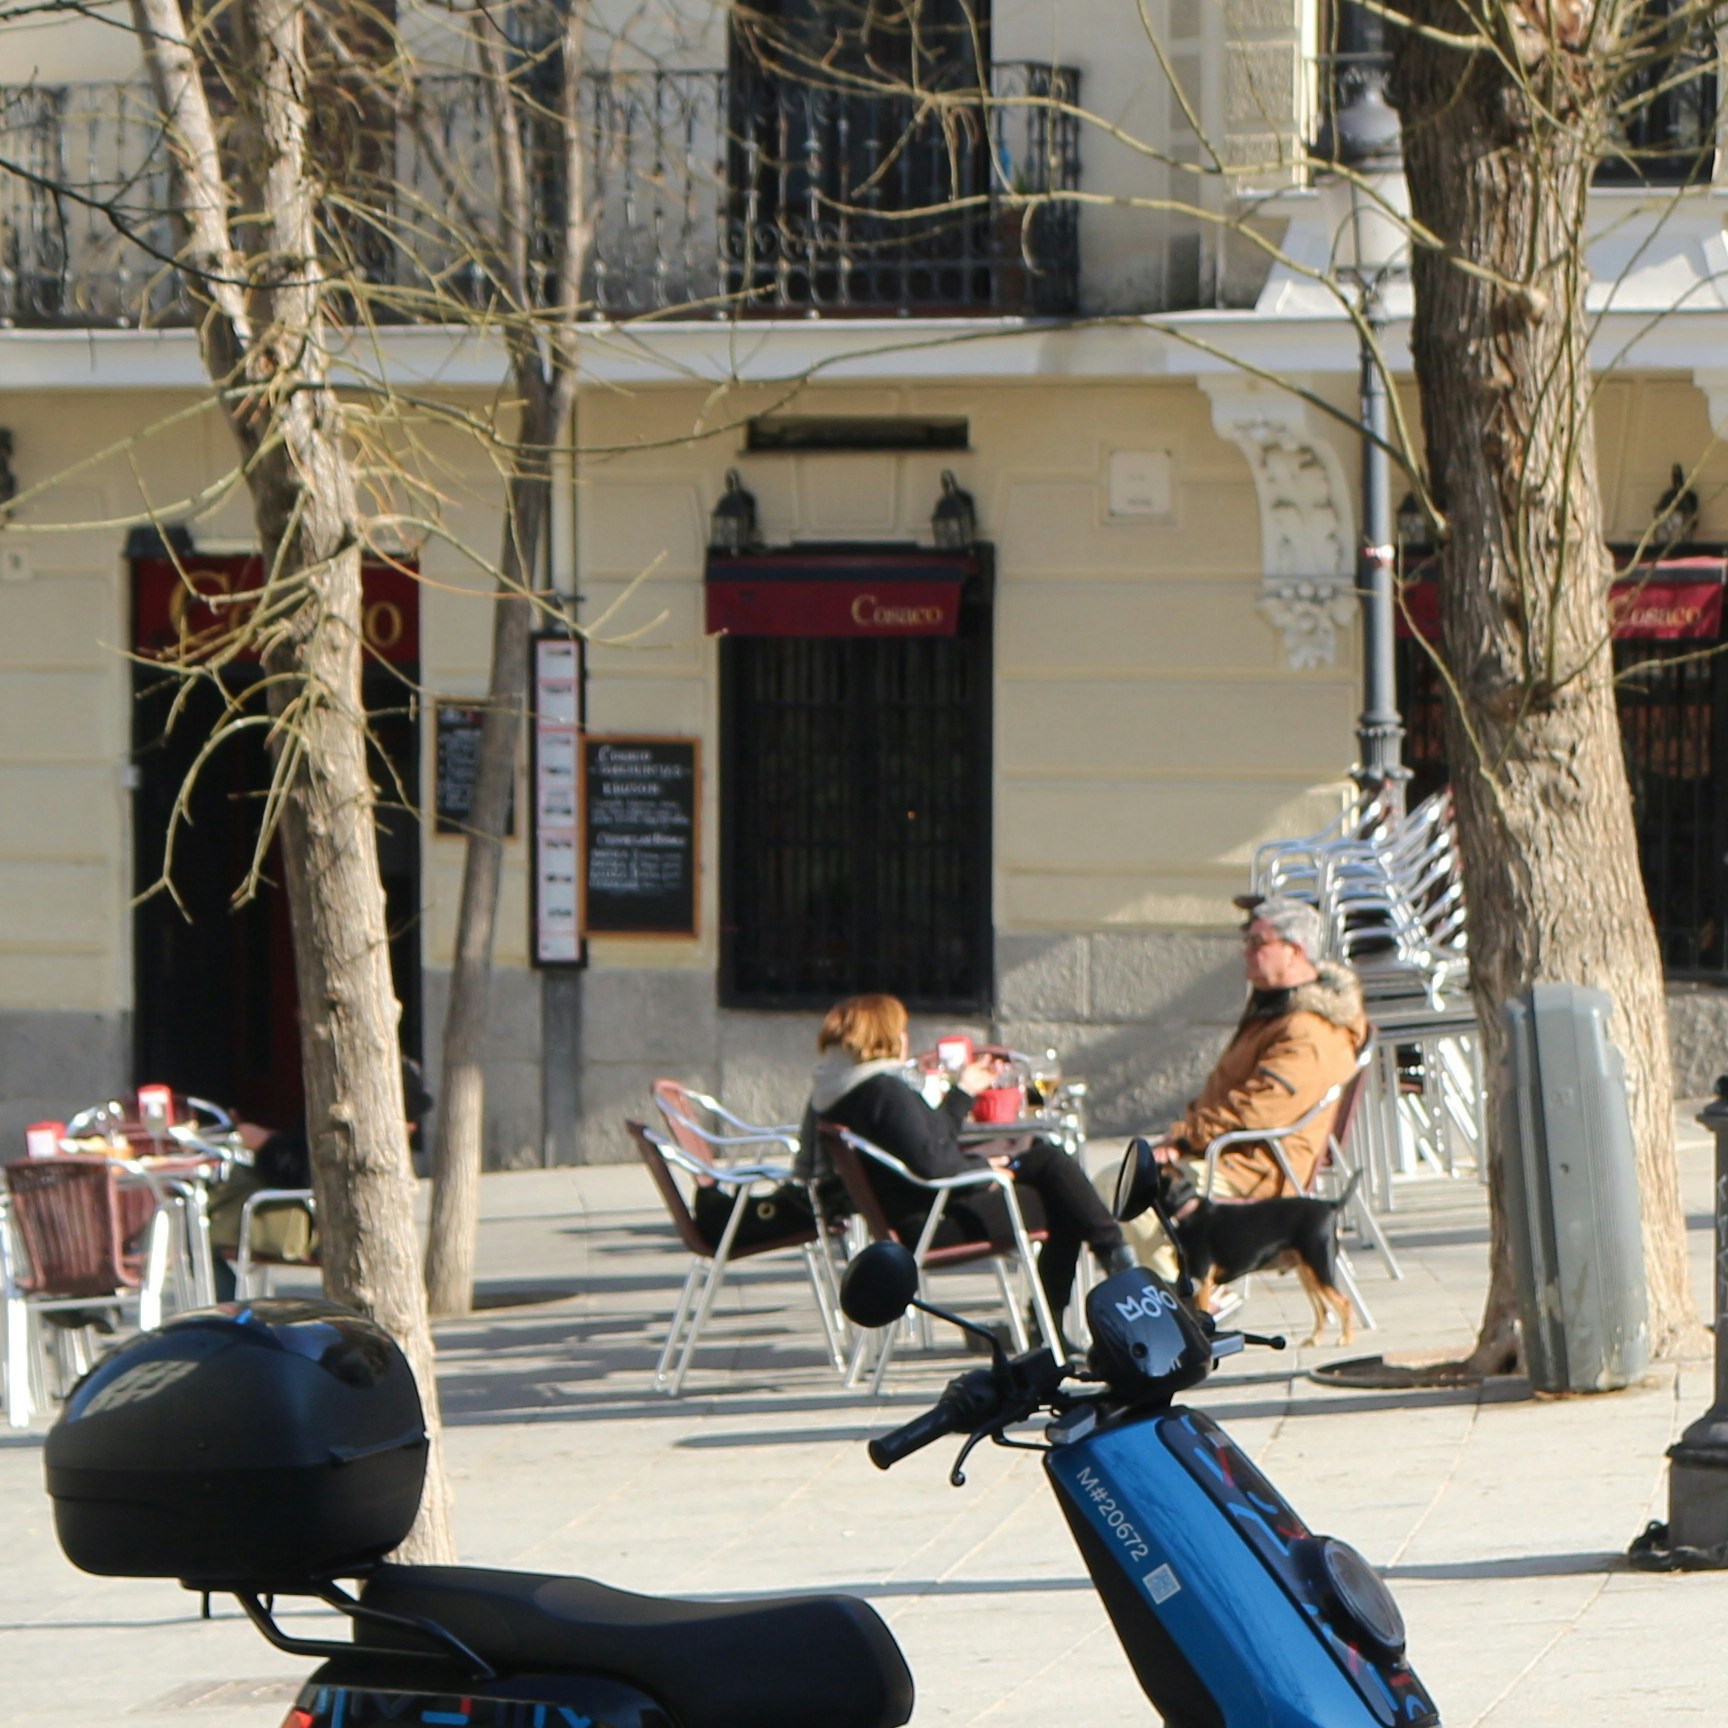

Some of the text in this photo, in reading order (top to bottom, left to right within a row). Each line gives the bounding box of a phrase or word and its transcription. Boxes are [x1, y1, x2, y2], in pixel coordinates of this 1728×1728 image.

[850, 593, 944, 626] Cosaco
[1115, 1285, 1178, 1322] MOVO
[1076, 1466, 1149, 1562] M#20672
